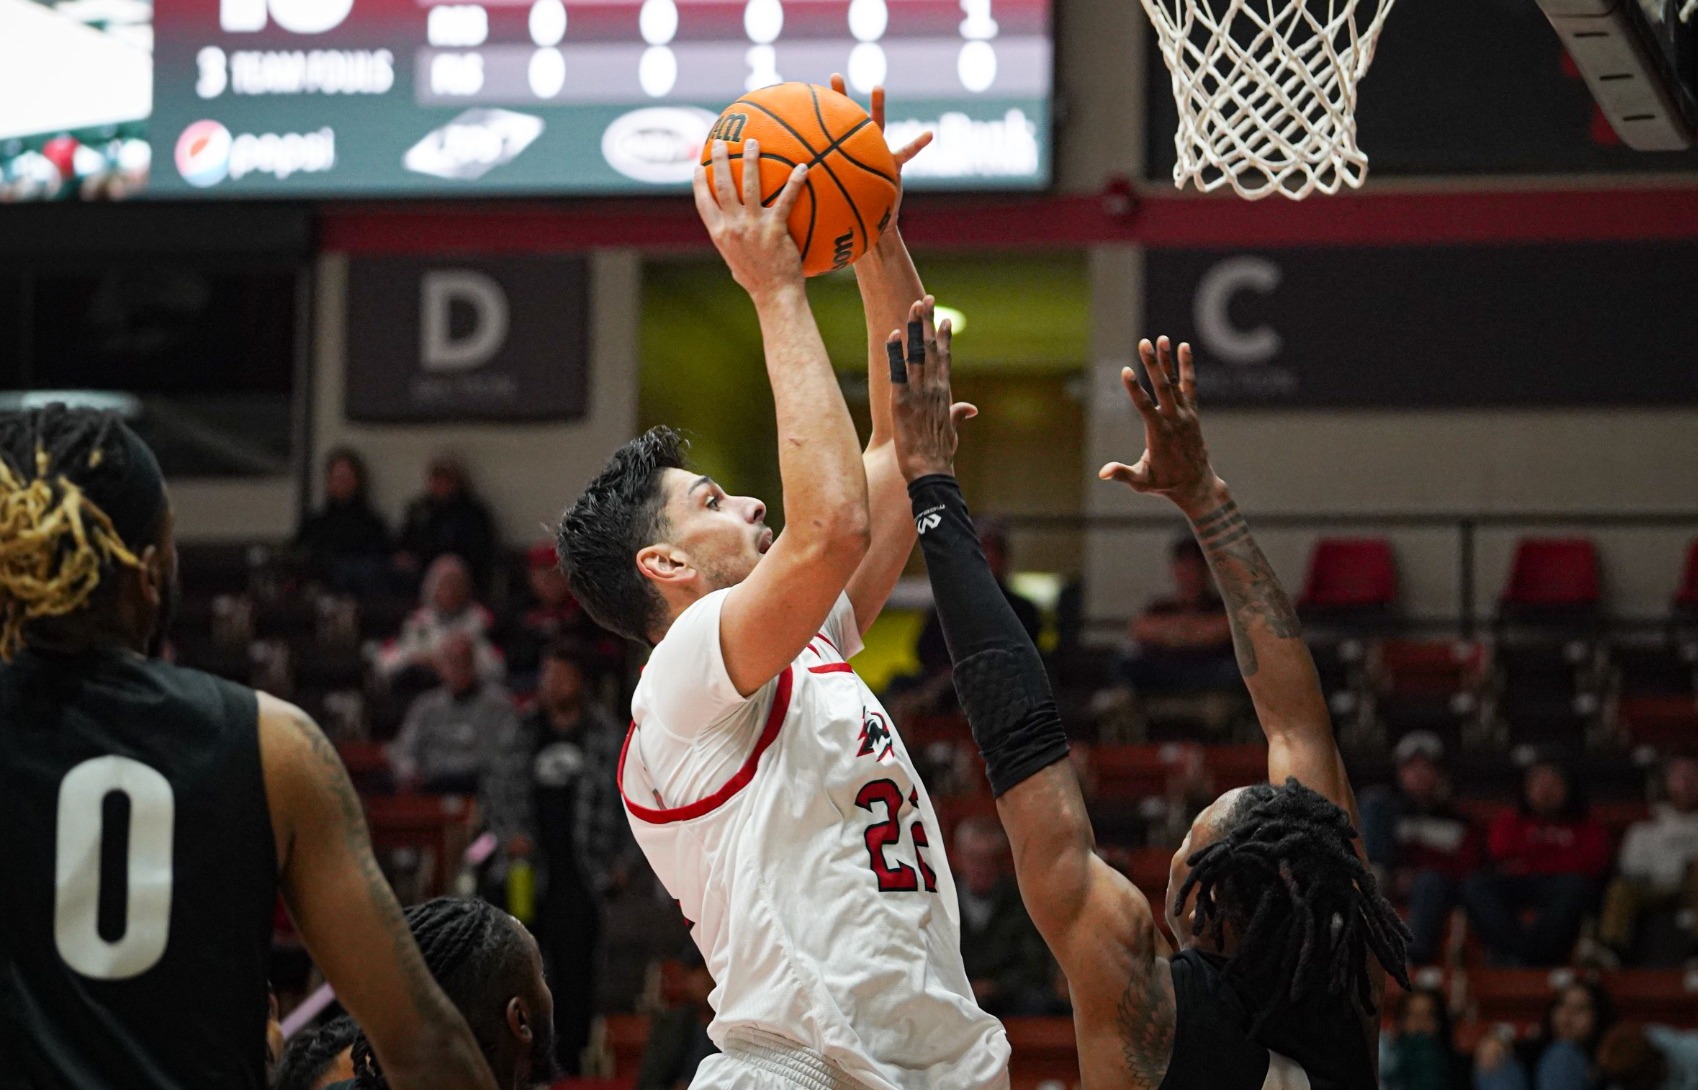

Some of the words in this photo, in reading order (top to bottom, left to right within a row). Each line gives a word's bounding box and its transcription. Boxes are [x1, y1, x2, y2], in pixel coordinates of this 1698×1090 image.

[196, 46, 227, 98] 3
[420, 270, 509, 370] D
[1194, 257, 1282, 362] C
[54, 755, 175, 981] 0
